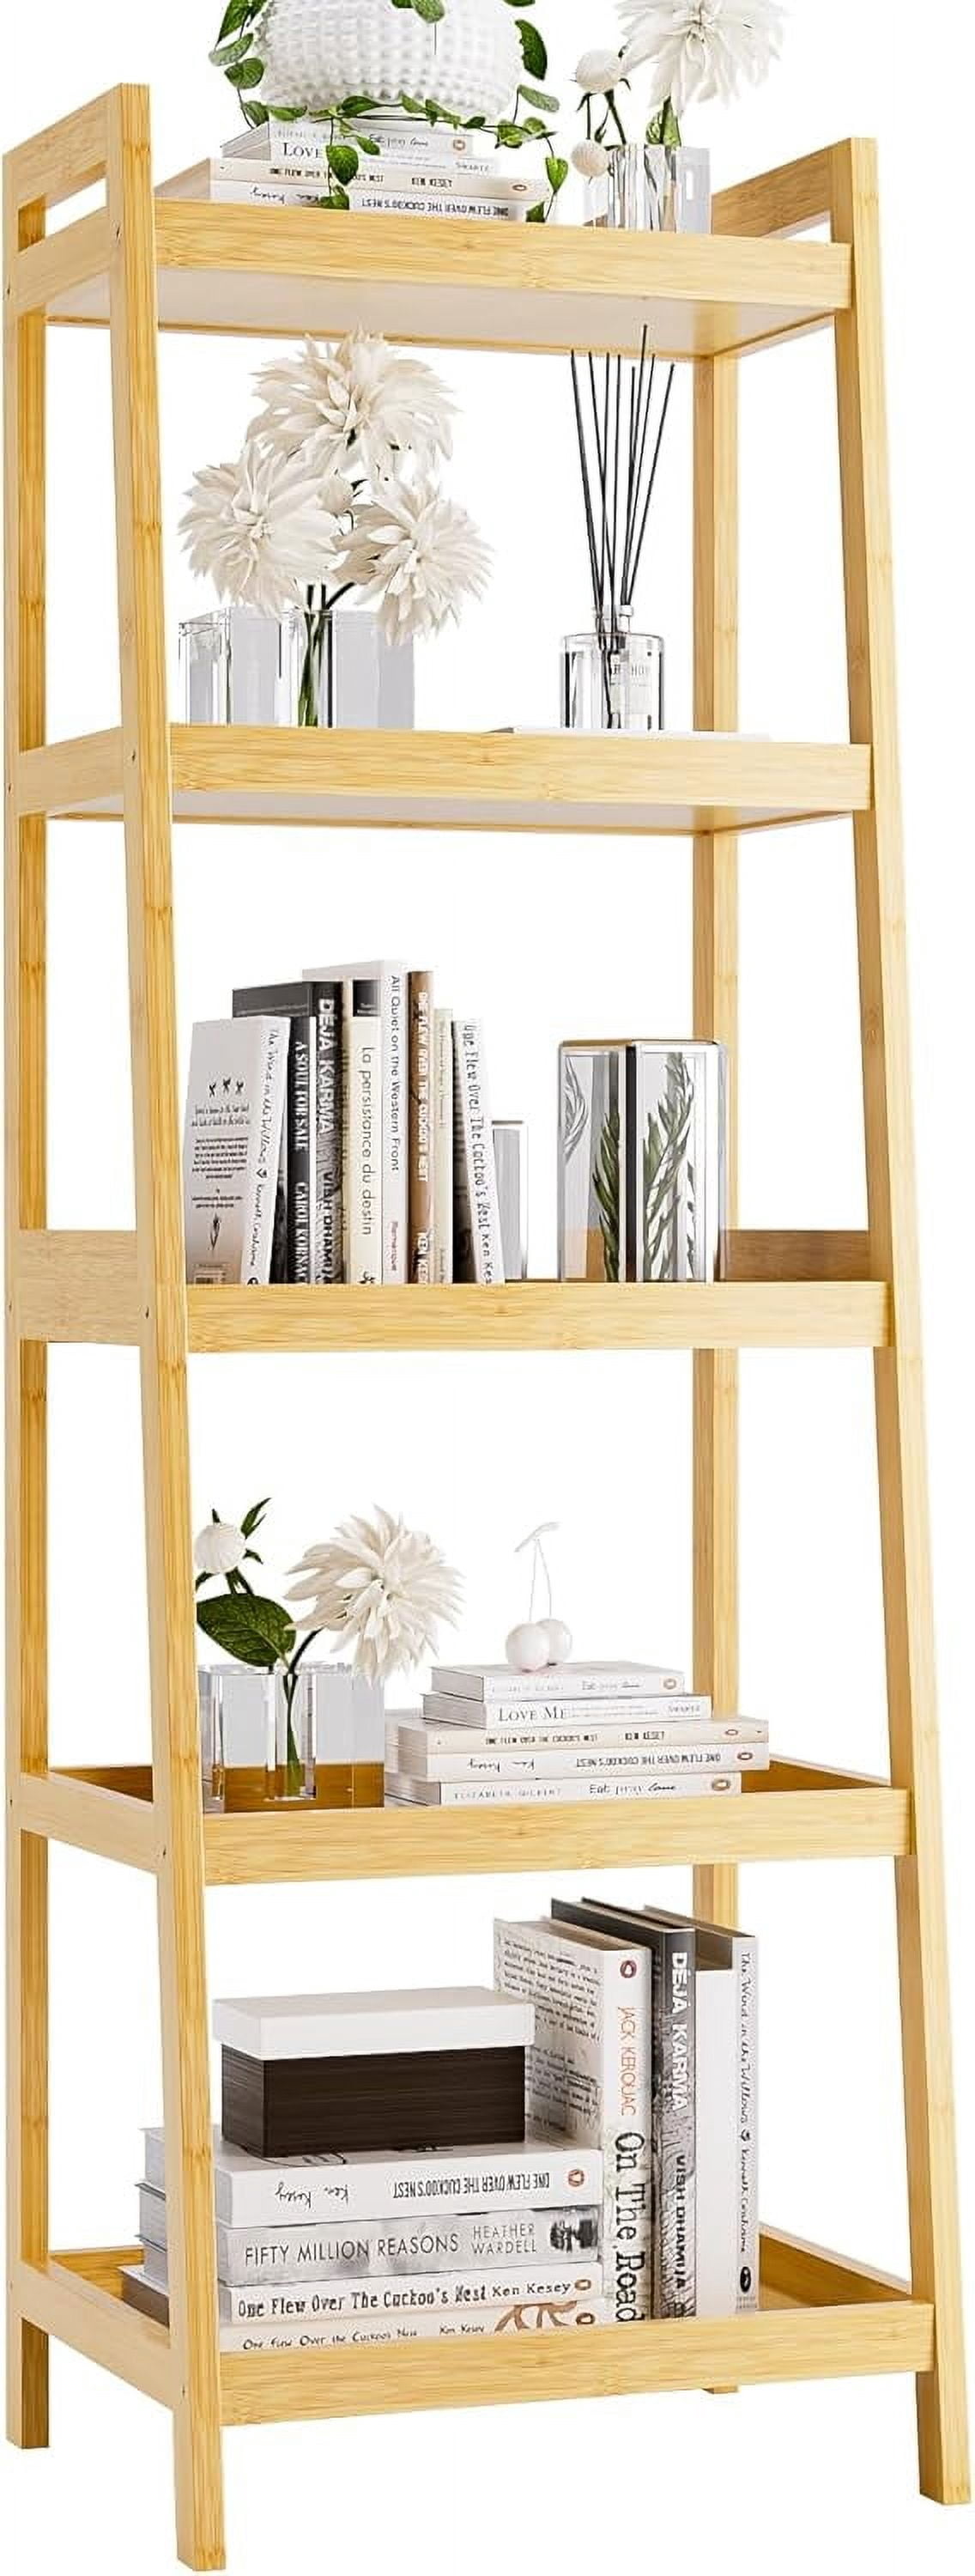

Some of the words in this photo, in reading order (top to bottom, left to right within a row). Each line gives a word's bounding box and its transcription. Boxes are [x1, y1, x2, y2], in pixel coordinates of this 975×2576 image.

[427, 202, 443, 212] THE
[445, 204, 467, 213] OVER
[468, 205, 492, 215] FLEW
[391, 975, 401, 993] All
[391, 997, 401, 1032] Quiet
[294, 1041, 309, 1052] A
[391, 1034, 400, 1052] on
[462, 1024, 477, 1047] One
[361, 1046, 376, 1064] La
[391, 1054, 399, 1077] the
[464, 1051, 480, 1078] Flew
[294, 1052, 309, 1089] SOUL
[294, 1091, 309, 1116] FOR
[318, 1060, 336, 1134] KARMA
[391, 1080, 400, 1133] Western
[466, 1084, 481, 1111] Over
[294, 1118, 309, 1151] SALE
[469, 1116, 484, 1140] The
[391, 1138, 401, 1171] Front
[361, 1163, 377, 1184] du
[323, 1171, 334, 1210] VISH
[294, 1182, 310, 1227] CAROL
[361, 1189, 377, 1236] destin
[481, 1234, 494, 1257] Ken
[498, 1706, 537, 1722] LOVE
[575, 1757, 598, 1768] NEST
[641, 1755, 656, 1765] THE
[657, 1754, 680, 1765] OVER
[681, 1753, 704, 1764] FLEW
[705, 1752, 722, 1763] ONE
[589, 1783, 610, 1795] Eat
[617, 2007, 637, 2041] JACK
[671, 2023, 688, 2111] KARMA
[621, 2046, 637, 2117] KEROUAC
[740, 2064, 753, 2124] Willows
[615, 2131, 645, 2172] On
[417, 2177, 462, 2197] CUCKOO'S
[463, 2176, 481, 2194] THE
[482, 2174, 506, 2191] OVER
[508, 2172, 531, 2190] FLEW
[532, 2172, 550, 2189] ONE
[675, 2154, 687, 2200] VISH
[393, 2180, 417, 2198] NEST
[615, 2182, 646, 2241] The
[473, 2222, 535, 2240] HEATHER
[245, 2244, 289, 2268] FIFTY
[297, 2238, 370, 2263] MILLION
[378, 2233, 459, 2256] REASONS
[471, 2239, 536, 2255] WARDELL
[674, 2206, 687, 2290] DHAMIJA
[492, 2284, 520, 2298] Ken
[526, 2280, 572, 2296] Kesey
[615, 2251, 646, 2322] Road
[238, 2299, 264, 2318] One
[271, 2296, 306, 2316] Flew
[312, 2294, 344, 2312] Over
[350, 2290, 379, 2310] The
[384, 2287, 449, 2309] Cuckoo's
[455, 2284, 487, 2303] Nest
